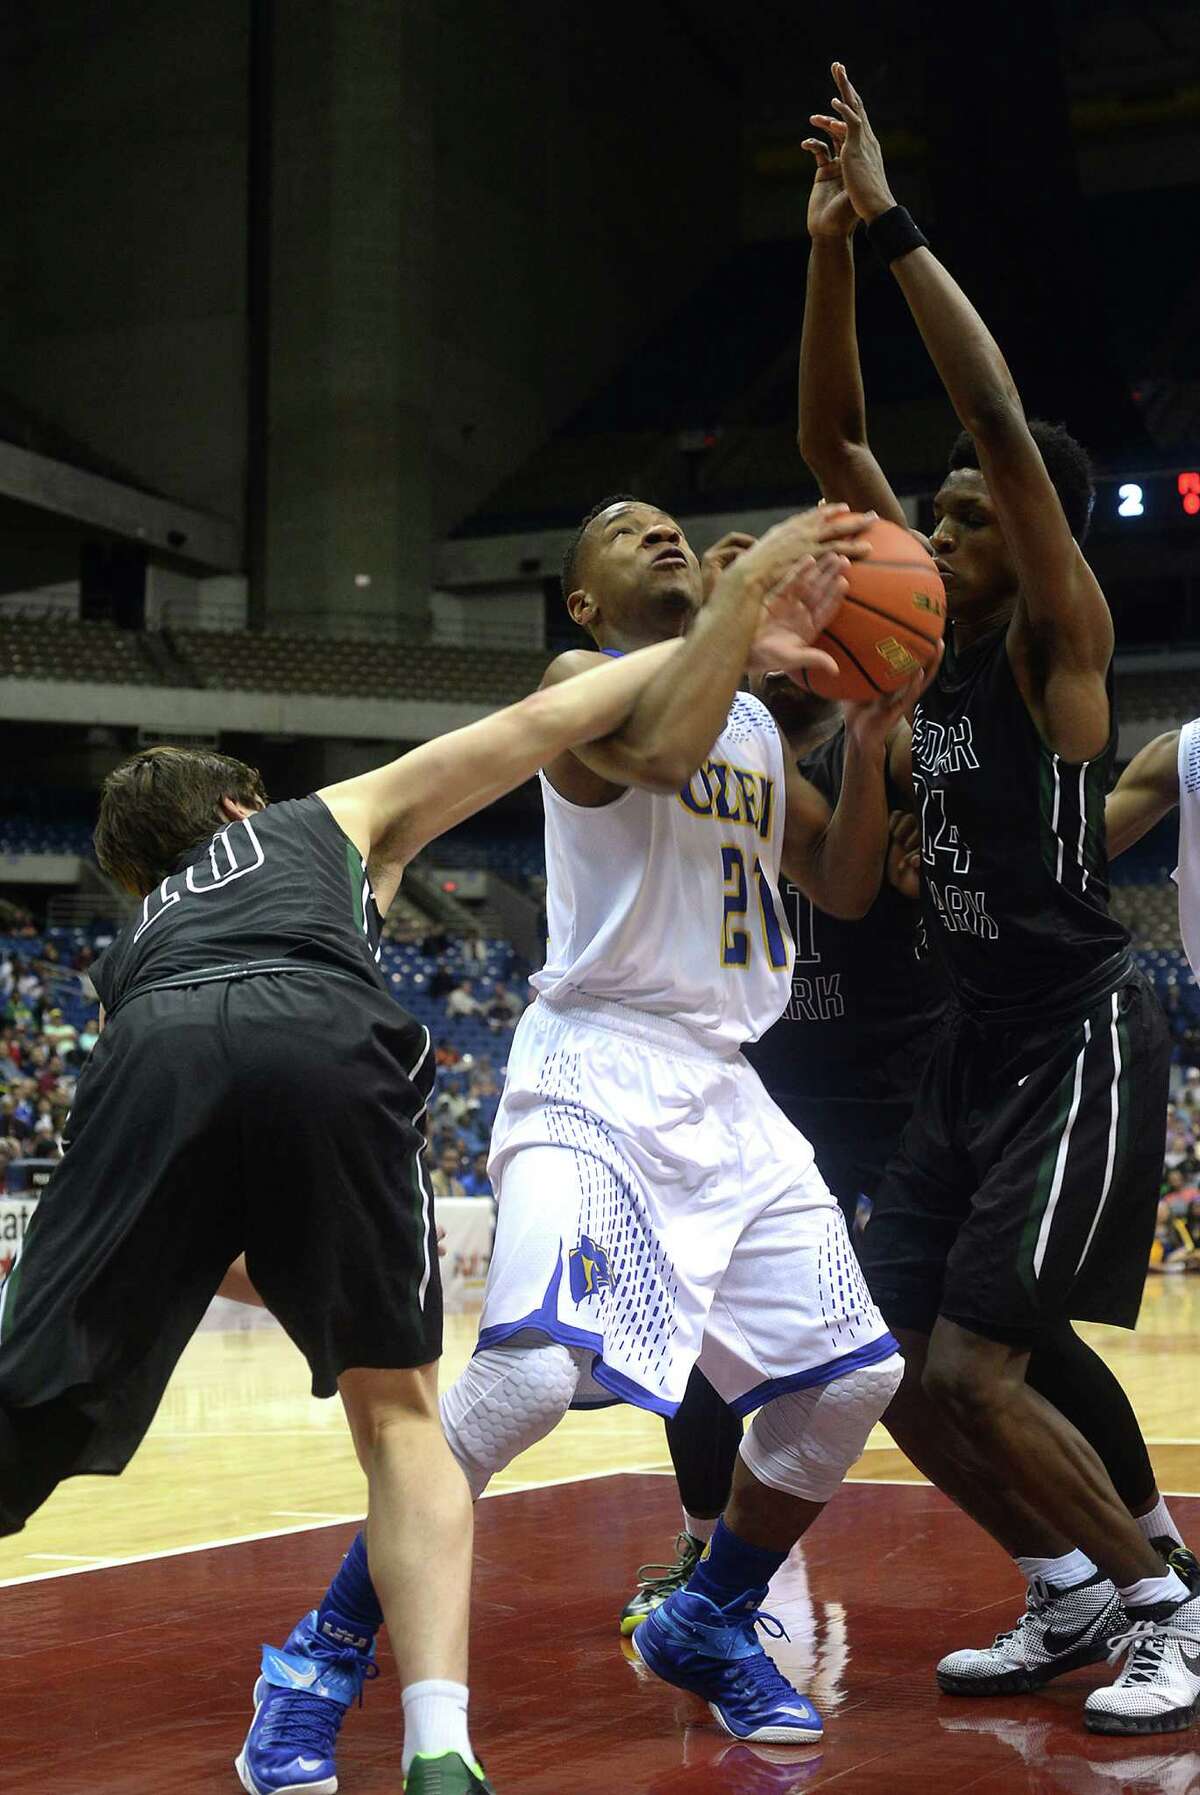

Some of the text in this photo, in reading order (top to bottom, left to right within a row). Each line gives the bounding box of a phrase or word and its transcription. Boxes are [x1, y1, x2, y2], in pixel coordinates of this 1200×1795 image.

[1118, 483, 1144, 517] 2
[719, 841, 790, 973] 21
[926, 876, 999, 940] ARK
[782, 972, 845, 1021] RK
